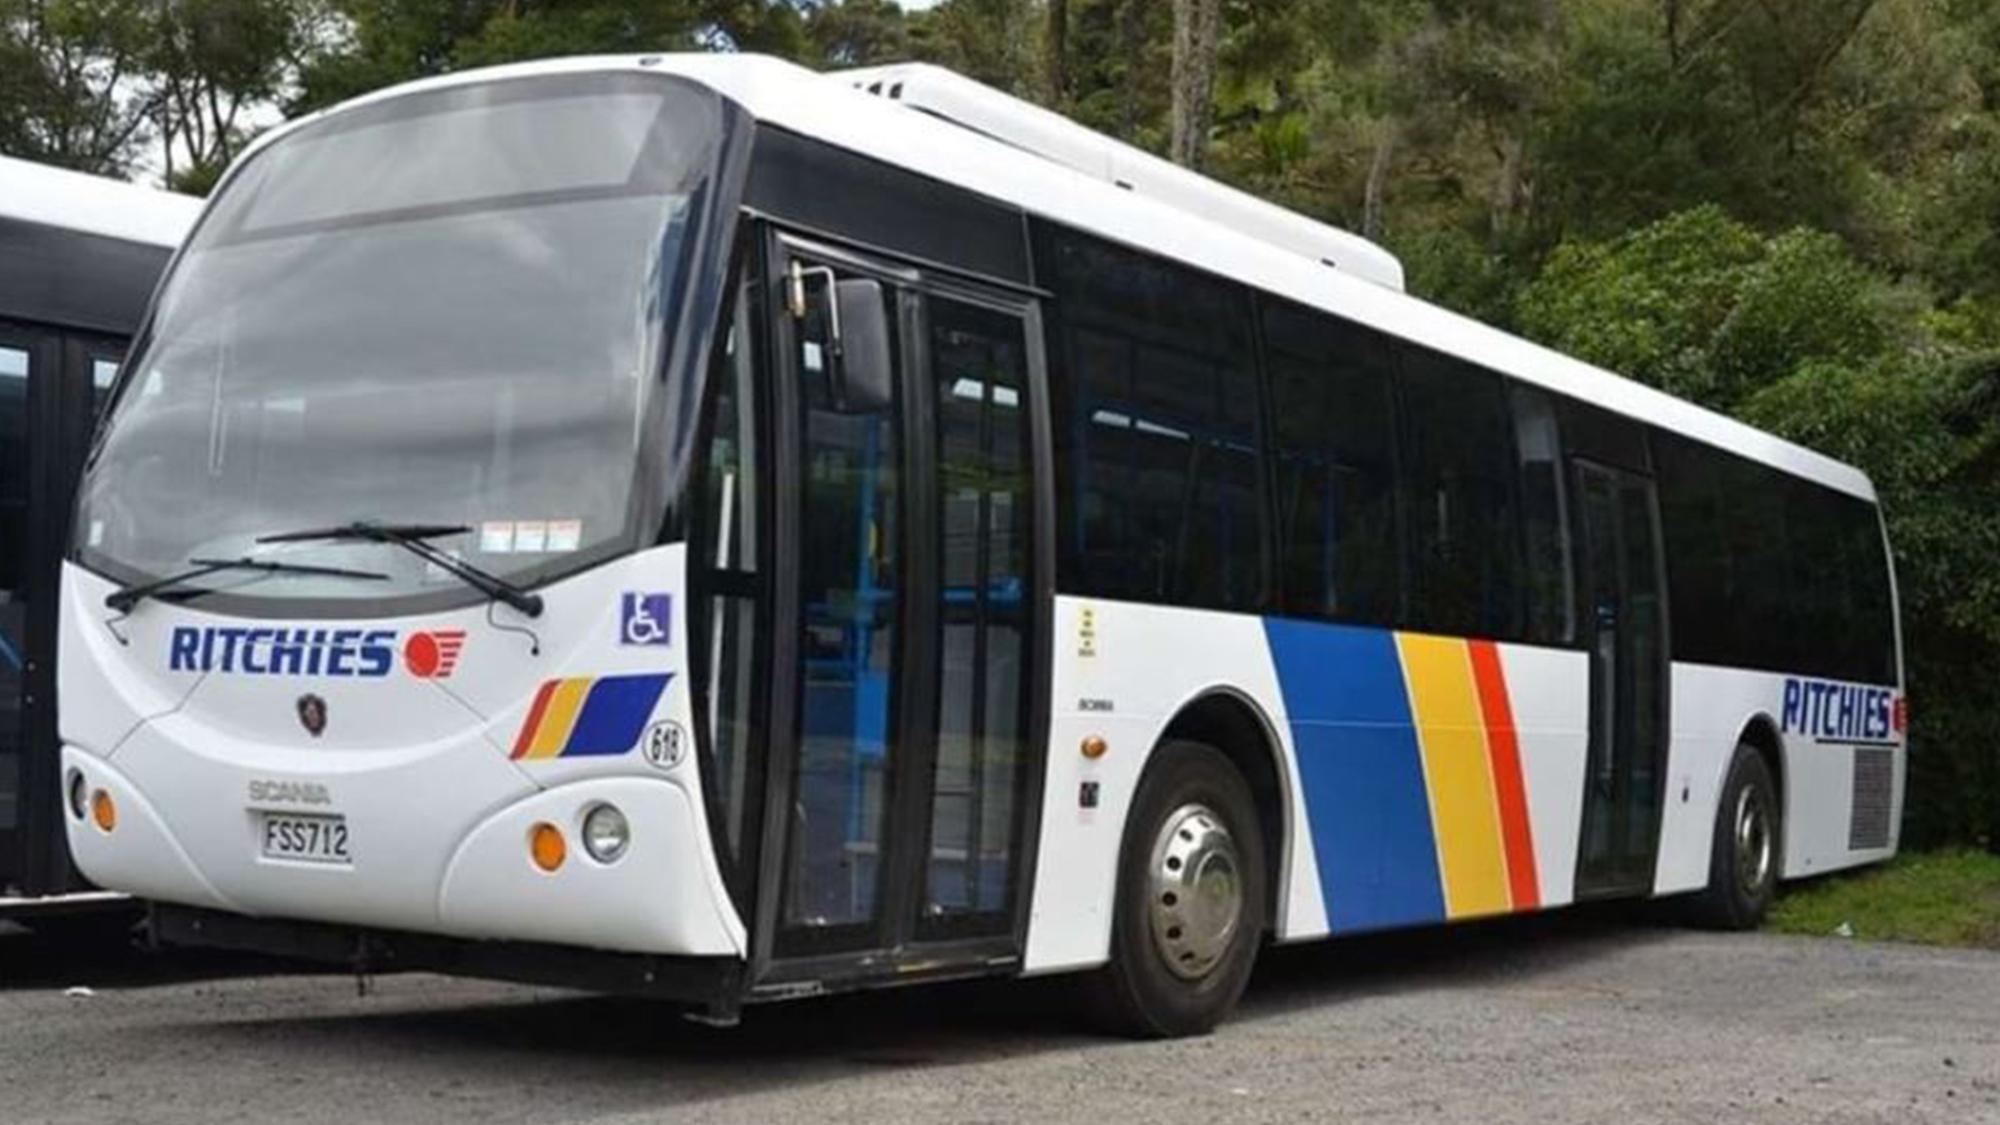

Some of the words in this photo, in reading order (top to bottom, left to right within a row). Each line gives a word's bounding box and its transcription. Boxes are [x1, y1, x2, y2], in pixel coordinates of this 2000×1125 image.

[169, 627, 396, 677] RITCHIES
[1782, 679, 1891, 739] RITCHIES
[652, 727, 680, 761] 618
[249, 780, 332, 805] SCANIA
[266, 820, 347, 856] FSS712
